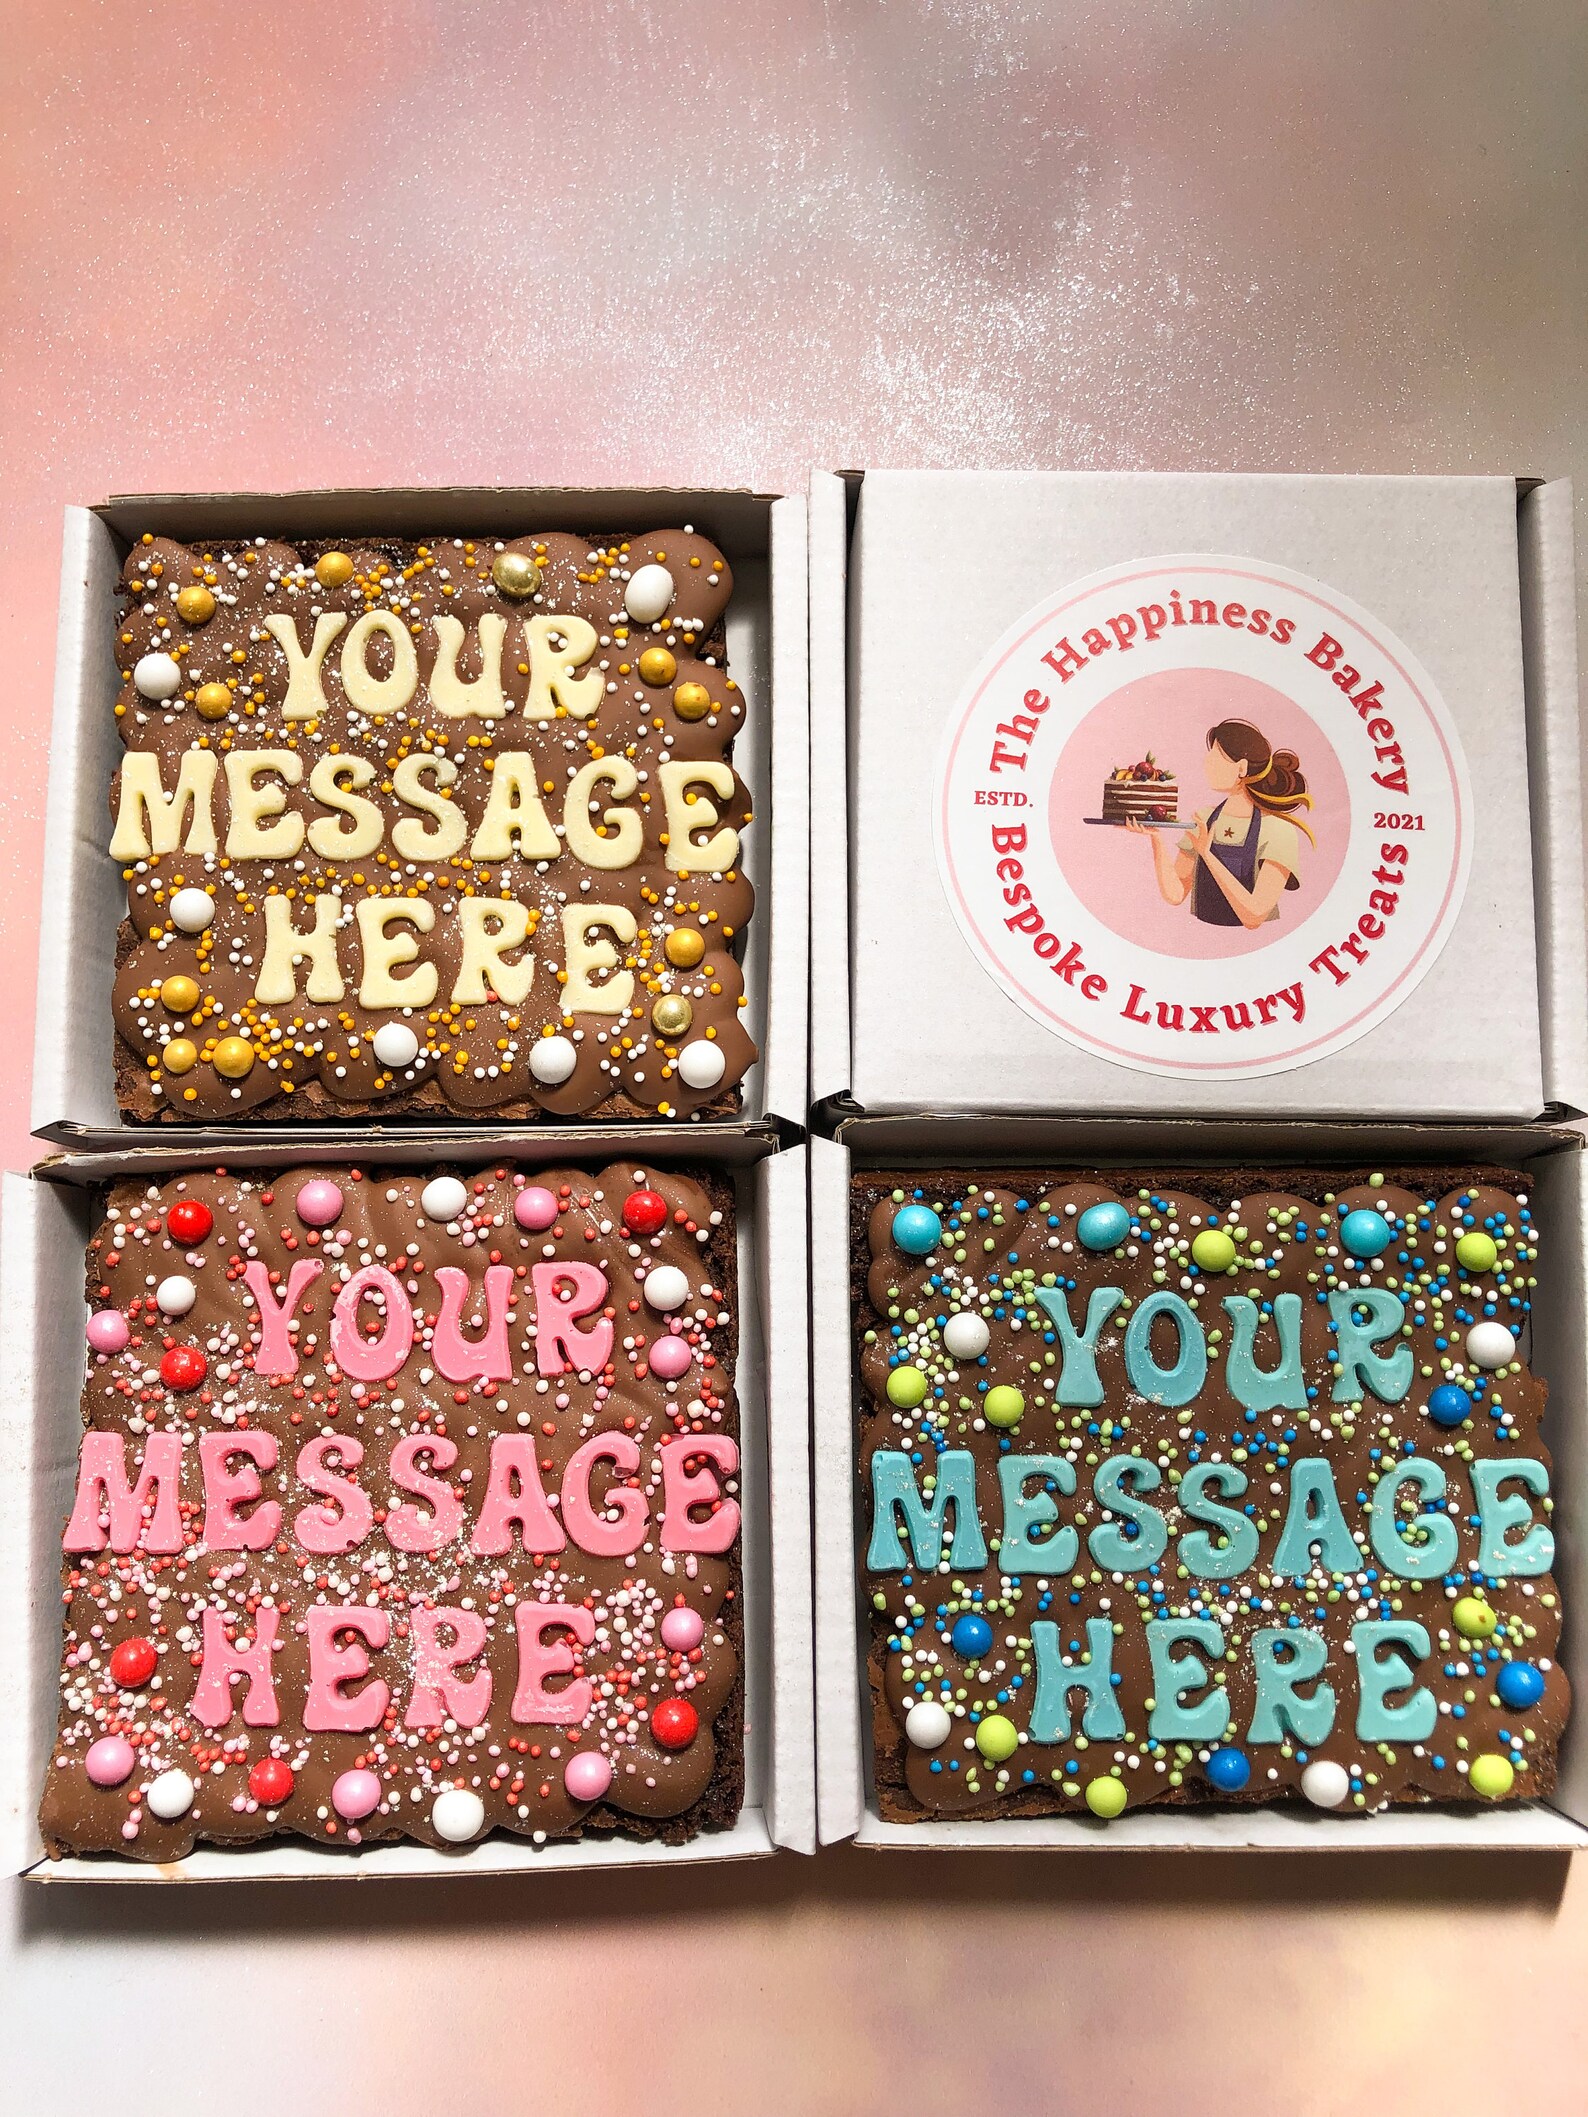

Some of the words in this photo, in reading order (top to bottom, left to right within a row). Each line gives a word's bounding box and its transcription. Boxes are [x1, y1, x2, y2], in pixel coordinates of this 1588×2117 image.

[264, 610, 605, 721] YOUR
[989, 688, 1050, 774] The
[1041, 589, 1297, 683] Happiness
[1304, 632, 1409, 796] Bakery
[109, 749, 739, 873] MESSAGE
[974, 790, 1034, 808] ESTD.
[1373, 812, 1426, 831] 2021
[254, 894, 638, 1014] HERE
[991, 822, 1108, 1002] Bespoke
[1119, 982, 1305, 1033] Luxury
[1309, 842, 1409, 987] Treats
[242, 1259, 615, 1383] YOUR
[1035, 1286, 1414, 1411] YOUR
[62, 1431, 742, 1557] MESSAGE
[866, 1450, 1556, 1580] MESSAGE
[190, 1601, 596, 1732] HERE
[1028, 1618, 1438, 1747] HERE
